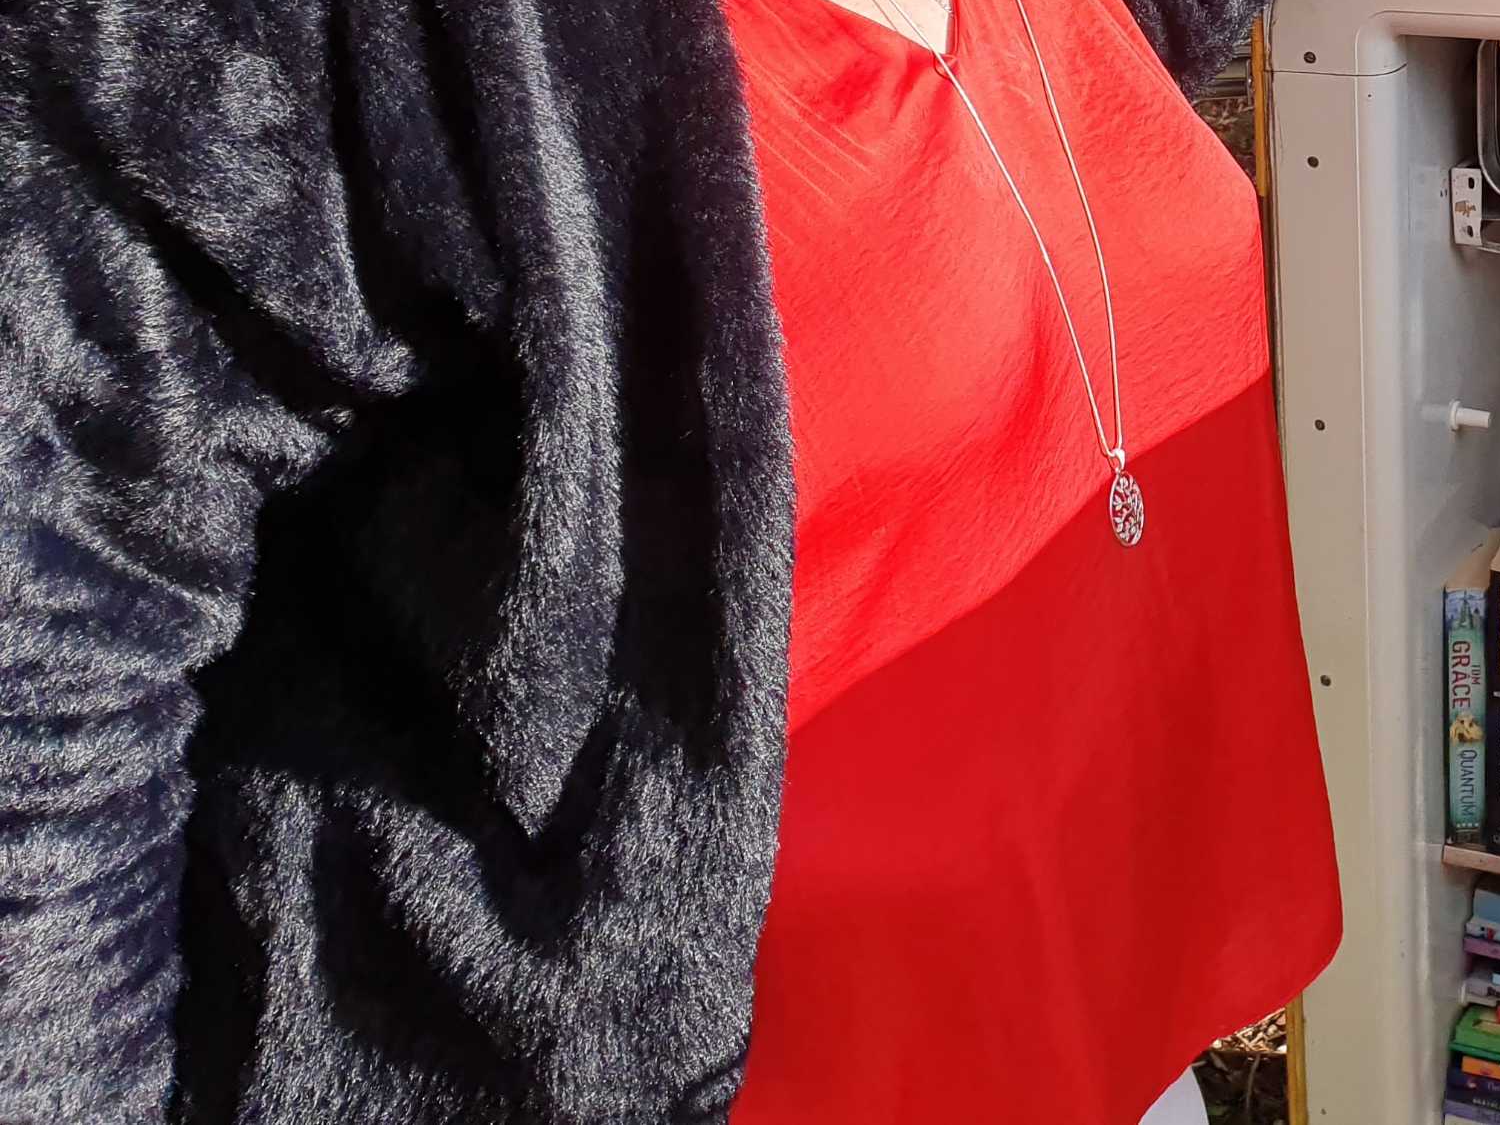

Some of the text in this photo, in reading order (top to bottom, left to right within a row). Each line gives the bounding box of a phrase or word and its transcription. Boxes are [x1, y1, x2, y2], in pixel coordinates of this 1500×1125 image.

[1452, 640, 1471, 709] GRACE
[1472, 663, 1481, 685] TOM
[1458, 749, 1478, 817] QUANTUM
